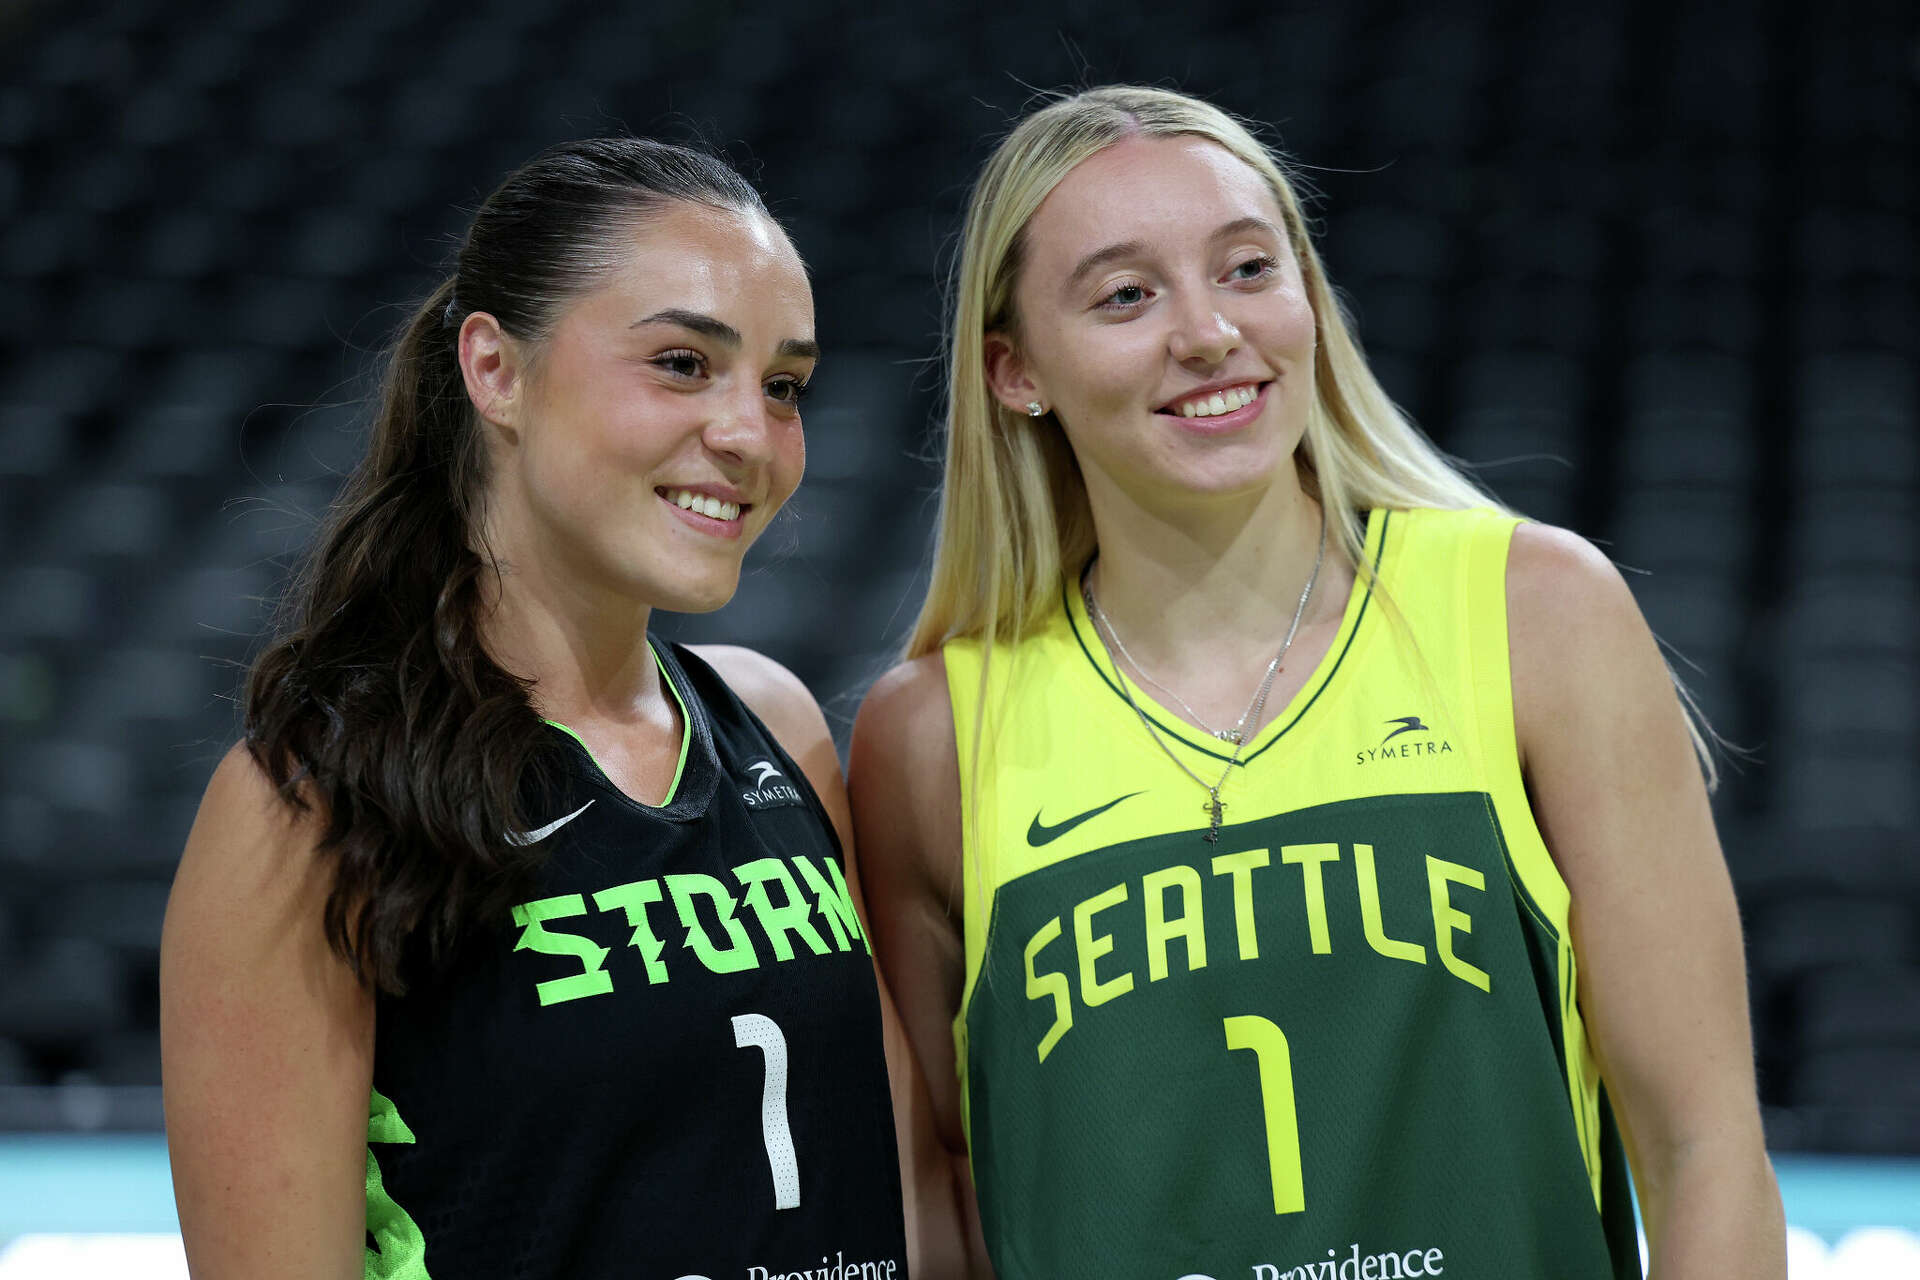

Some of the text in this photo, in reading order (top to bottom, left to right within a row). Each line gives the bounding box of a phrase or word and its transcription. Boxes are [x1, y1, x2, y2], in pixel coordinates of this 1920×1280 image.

[1356, 740, 1452, 765] SYMETRA
[511, 856, 872, 1006] STORM
[1024, 842, 1491, 1064] SEATTLE
[731, 1013, 800, 1210] 1
[1223, 1015, 1305, 1215] 1
[747, 1250, 896, 1280] idence
